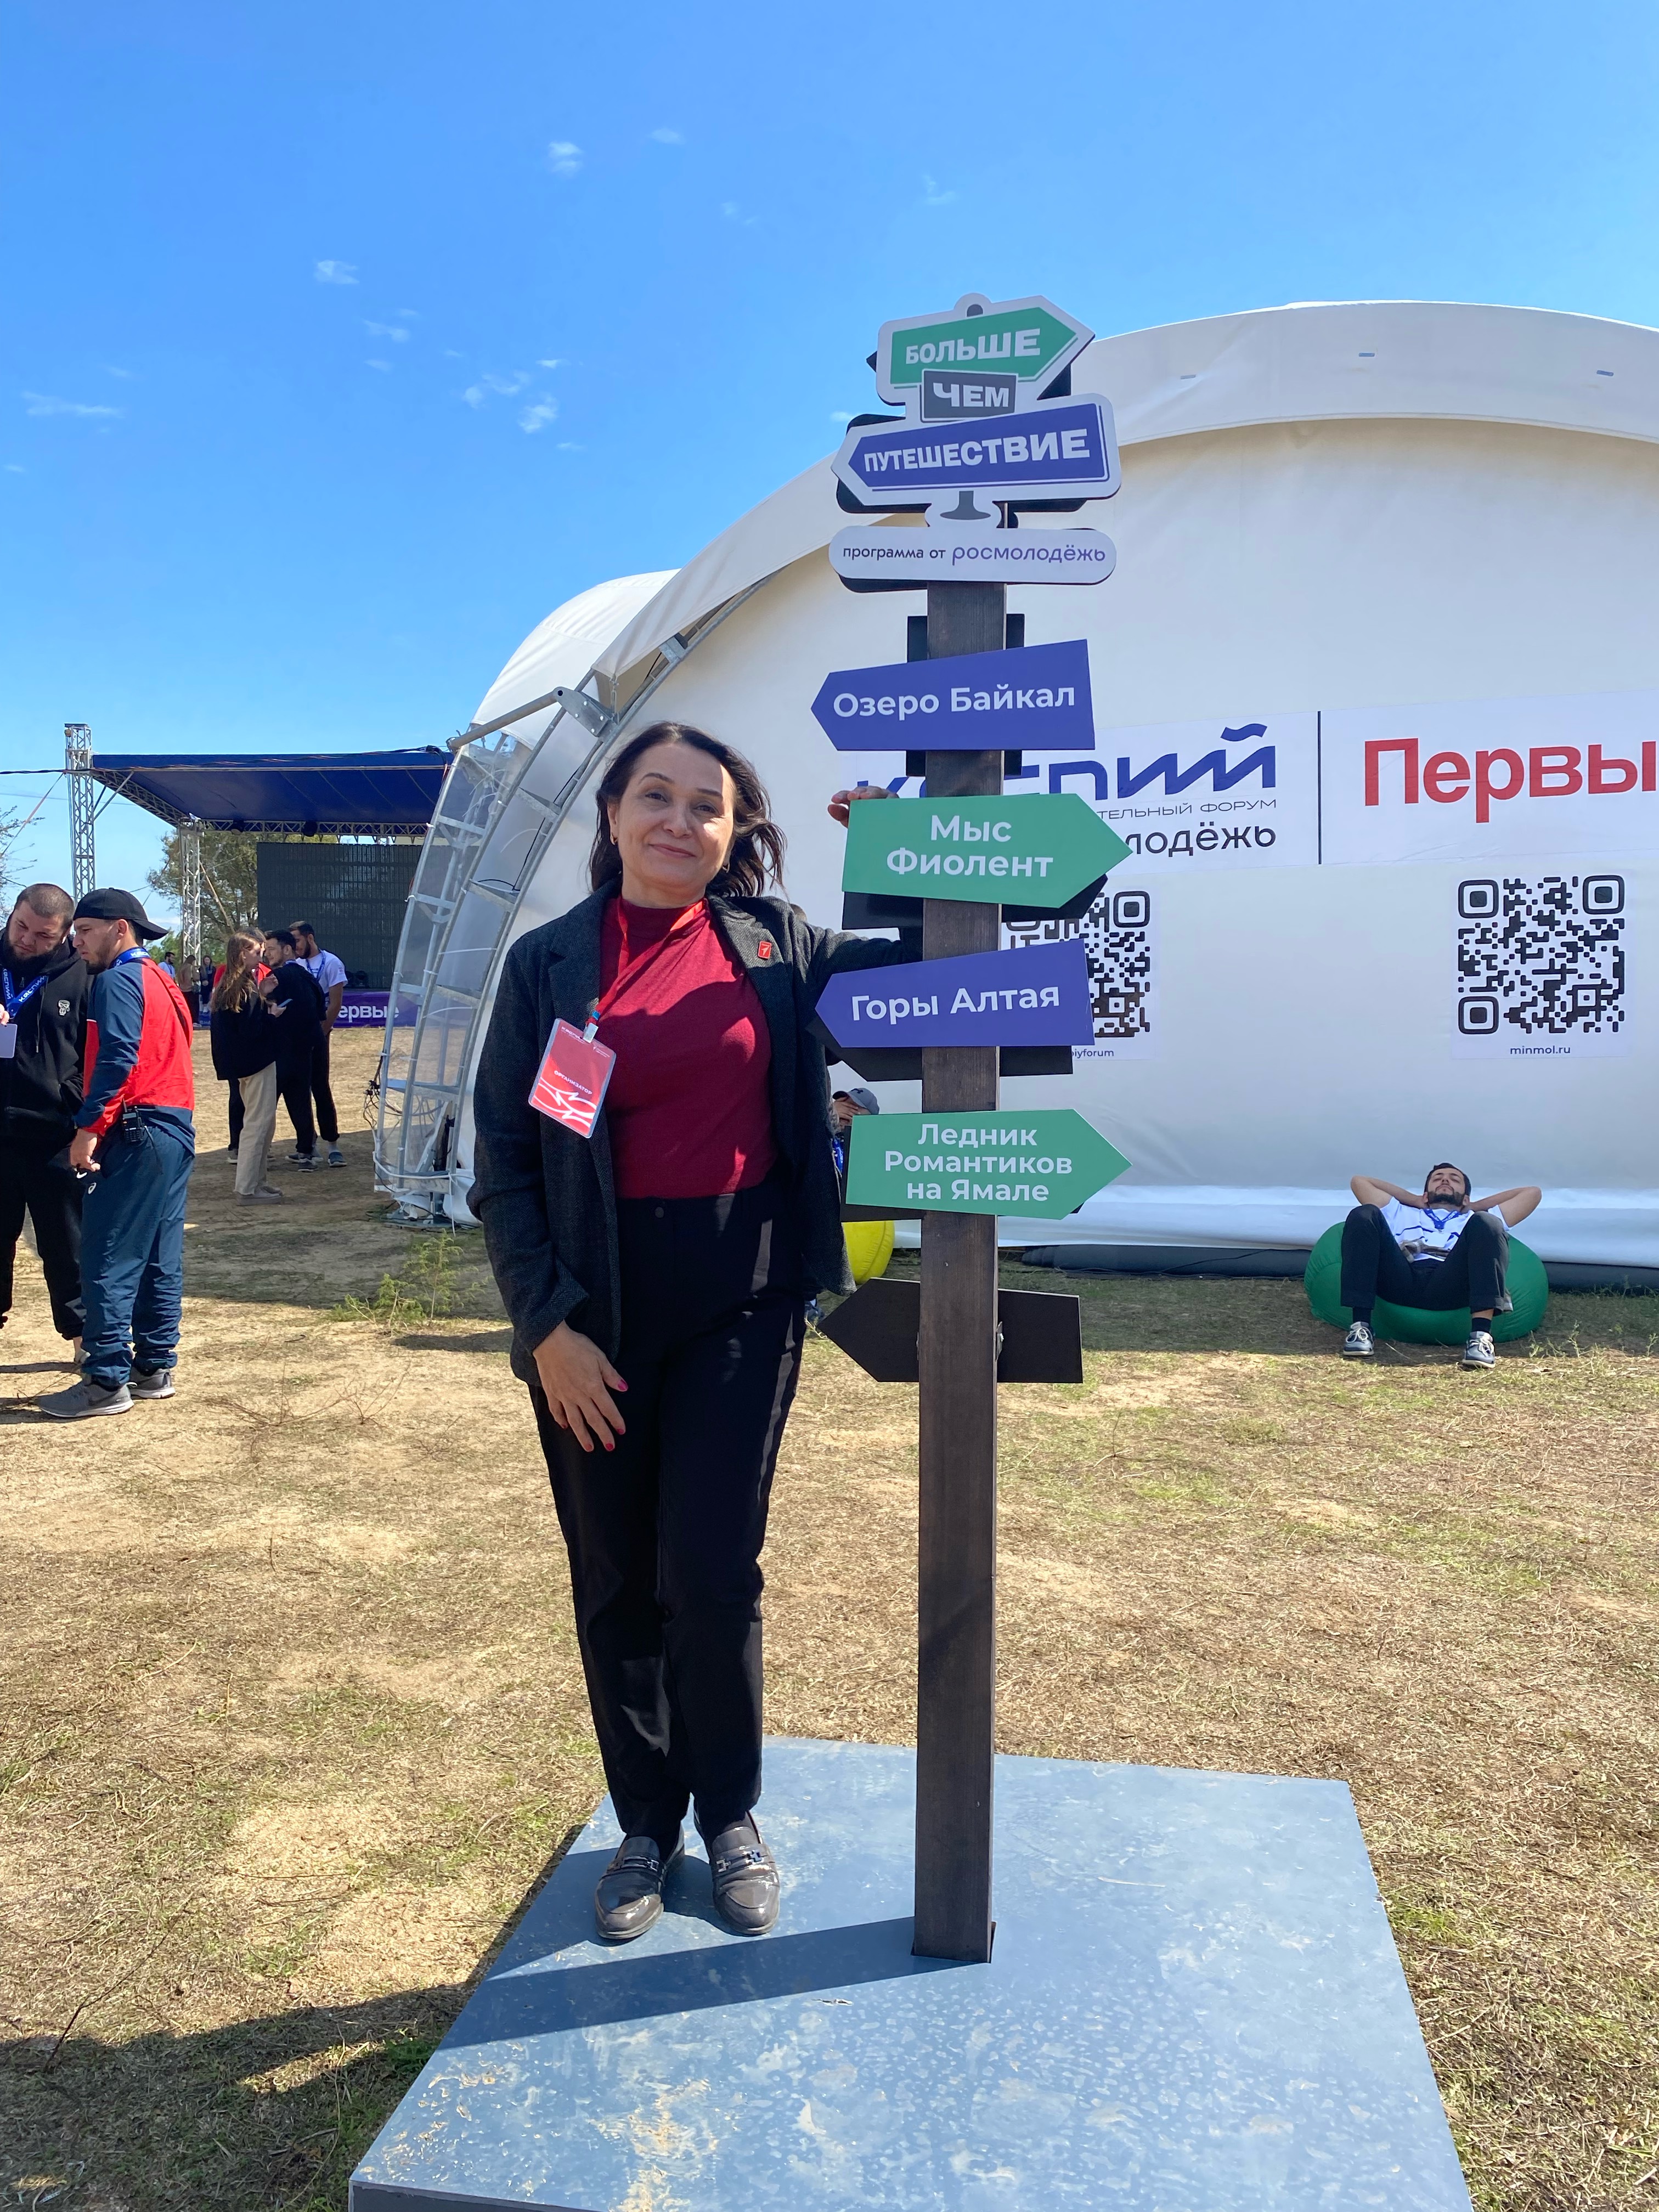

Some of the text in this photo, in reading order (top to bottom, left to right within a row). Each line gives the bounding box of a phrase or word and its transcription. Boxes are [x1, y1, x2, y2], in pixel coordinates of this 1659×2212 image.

[905, 328, 1041, 365] БОЛЬШЕ
[933, 382, 1009, 408] ЧЕМ
[864, 428, 1091, 472] ПУТЕШЕСТВИЕ
[843, 544, 1106, 566] программа от росмолодёжь
[833, 684, 1075, 721] Озеро Байкал
[1364, 737, 1657, 823] Первы
[1097, 799, 1277, 820] ТЕЛЬНЫЙ ФОРУМ
[930, 815, 1012, 842] Мыс
[1125, 821, 1276, 857] лодёжь
[887, 847, 1054, 877] Фиолент
[851, 986, 1060, 1025] Горы Алтая
[1510, 1045, 1571, 1054] minmol.ru
[554, 1070, 592, 1094] ОРГАНИЗАТОР
[918, 1123, 1037, 1148] Ледник
[885, 1150, 1073, 1175] Романтиков
[907, 1179, 1049, 1201] на Ямале
